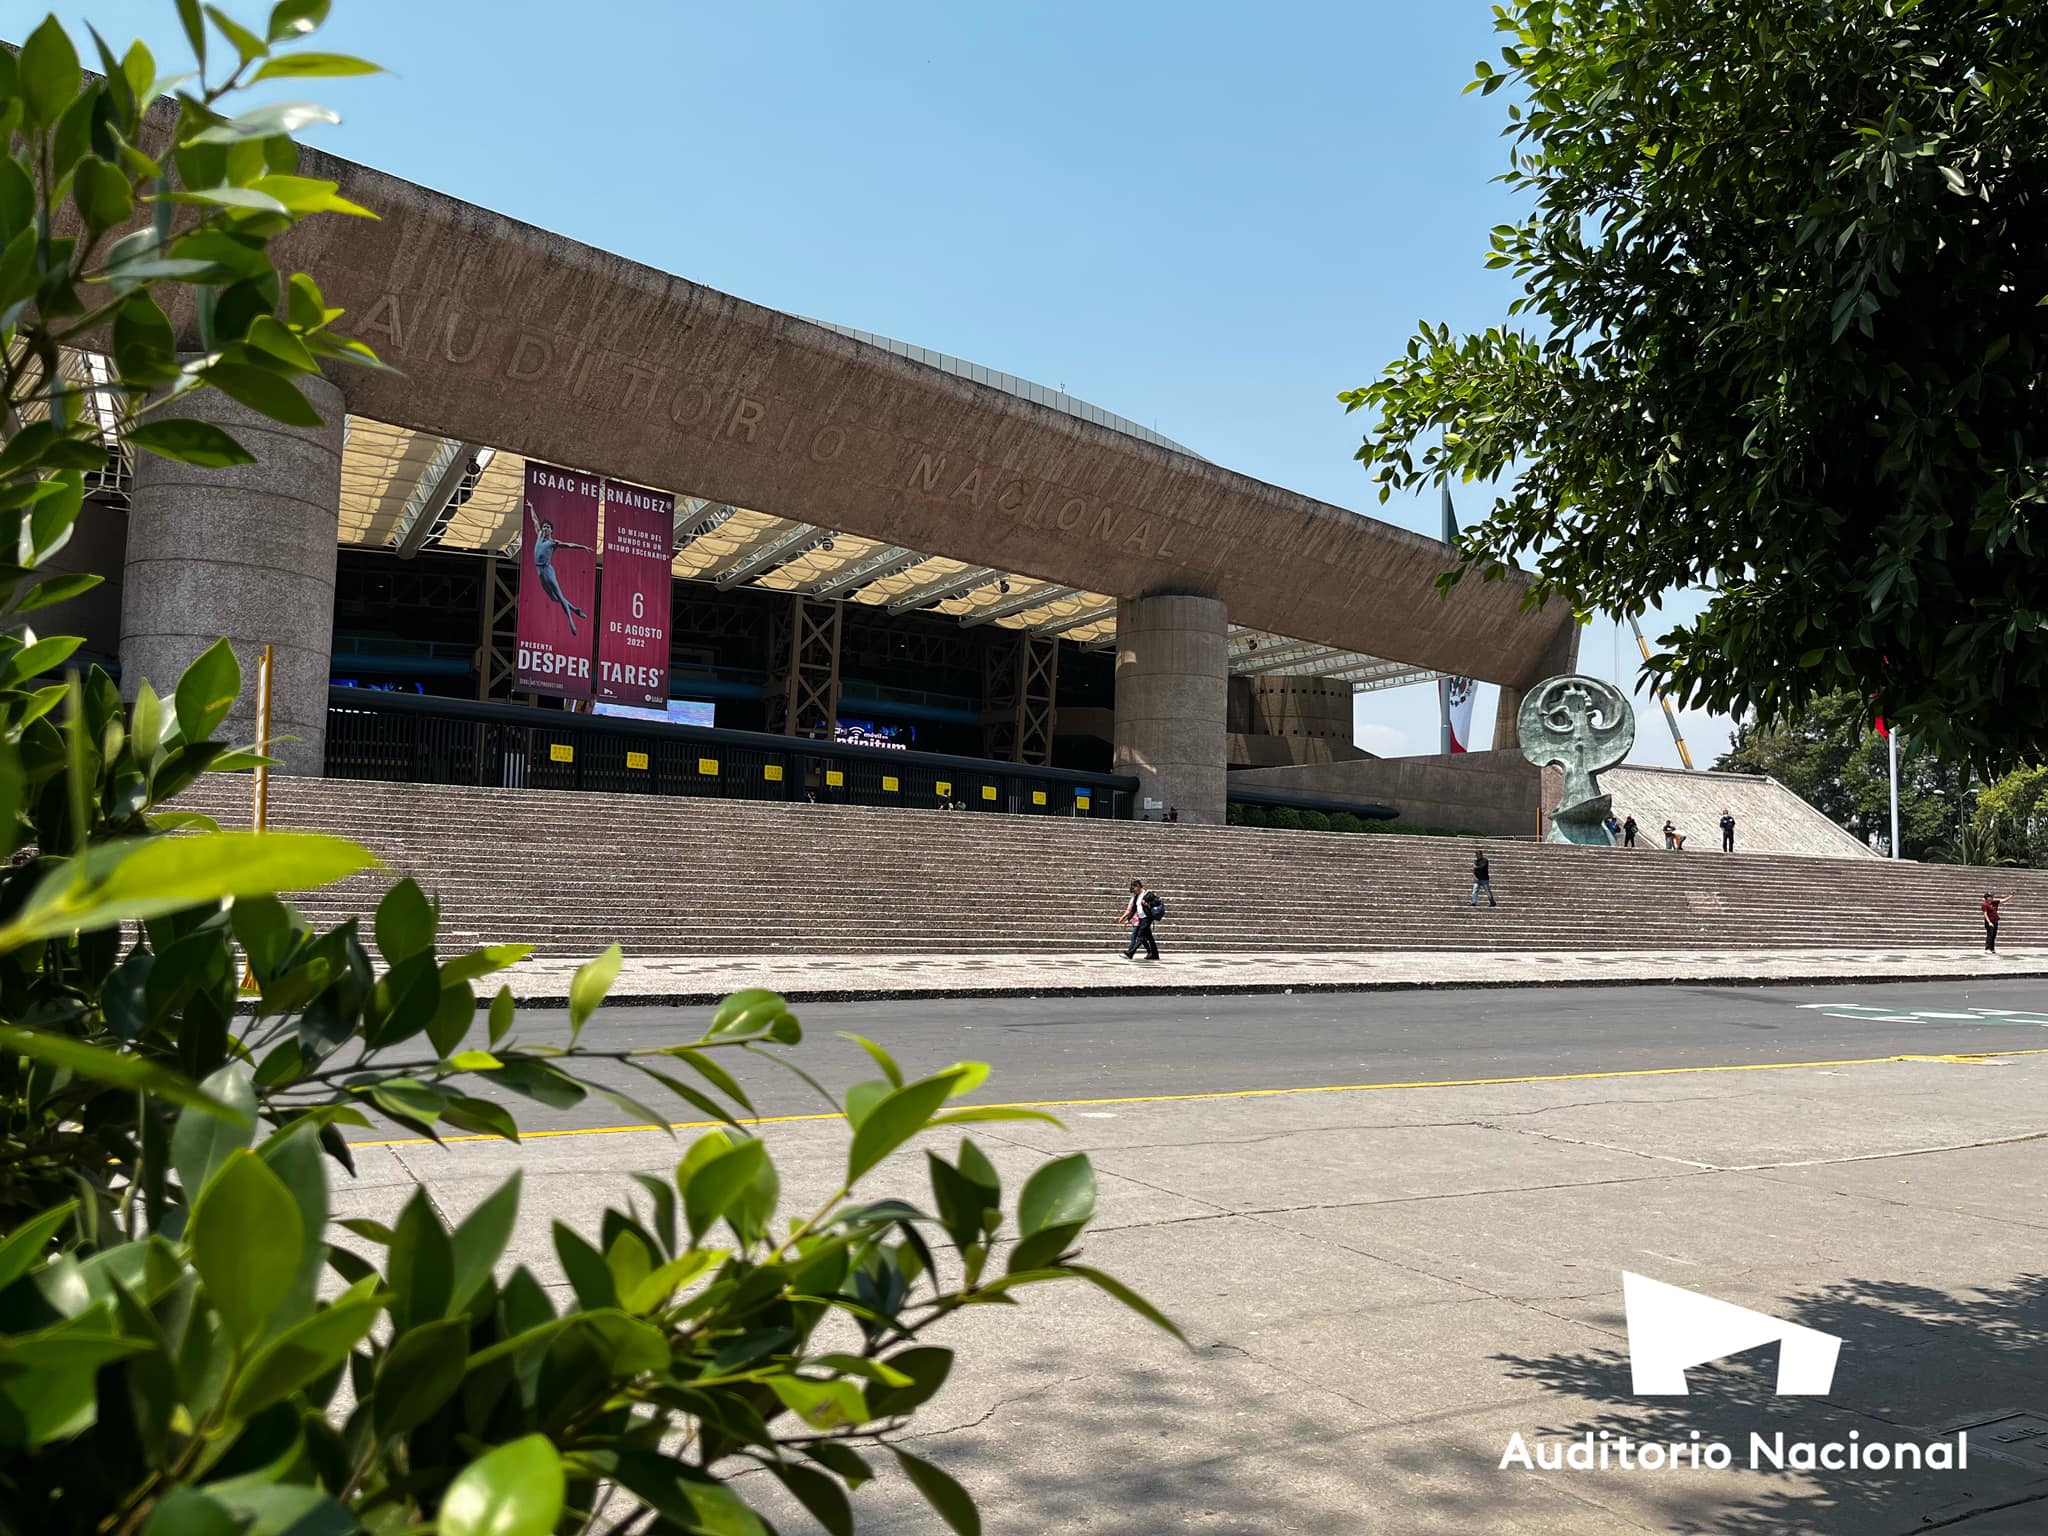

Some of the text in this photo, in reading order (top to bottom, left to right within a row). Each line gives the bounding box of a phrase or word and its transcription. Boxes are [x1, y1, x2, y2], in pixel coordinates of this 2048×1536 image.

[352, 294, 1178, 558] AUDITORIO NACIONAL
[533, 470, 575, 492] ISAAC
[617, 527, 662, 543] LO MEJOR DEL
[608, 543, 630, 554] MISMO
[617, 536, 662, 552] MUNDO EN UN
[632, 592, 644, 619] 6
[610, 621, 662, 640] DE AGOSTO
[520, 640, 553, 651] PRESENTA
[627, 637, 645, 648] 2022
